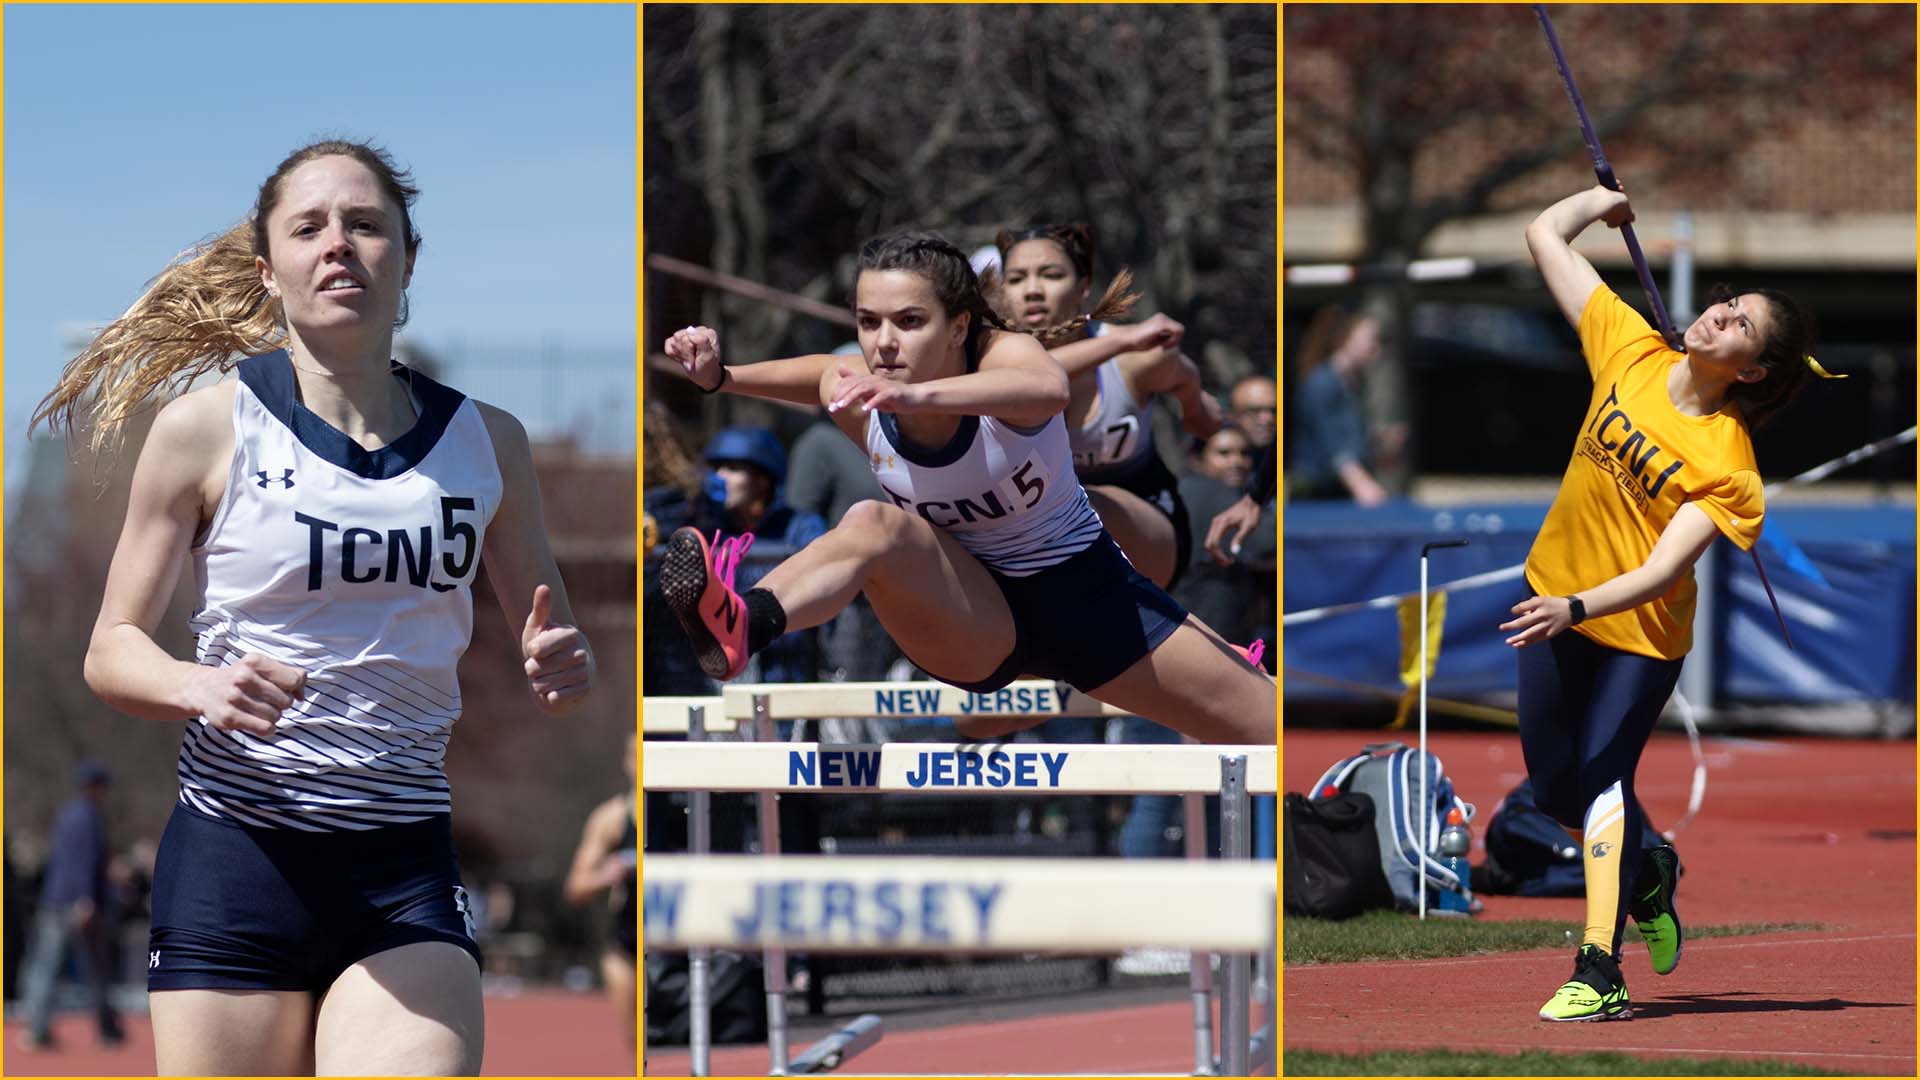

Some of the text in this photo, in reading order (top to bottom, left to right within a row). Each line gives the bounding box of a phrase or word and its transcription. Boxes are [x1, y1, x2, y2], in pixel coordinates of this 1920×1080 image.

[1107, 422, 1131, 459] 7
[1584, 440, 1609, 466] TRACK
[1616, 471, 1644, 501] FIELD
[1588, 382, 1684, 500] TCNJ
[881, 466, 1015, 528] TCN
[1011, 460, 1045, 509] 5
[294, 510, 457, 593] TCN
[440, 496, 476, 579] 5
[875, 687, 1072, 714] NEW JERSEY
[788, 750, 1069, 788] NEW JERSEY
[732, 880, 1003, 942] JERSEY
